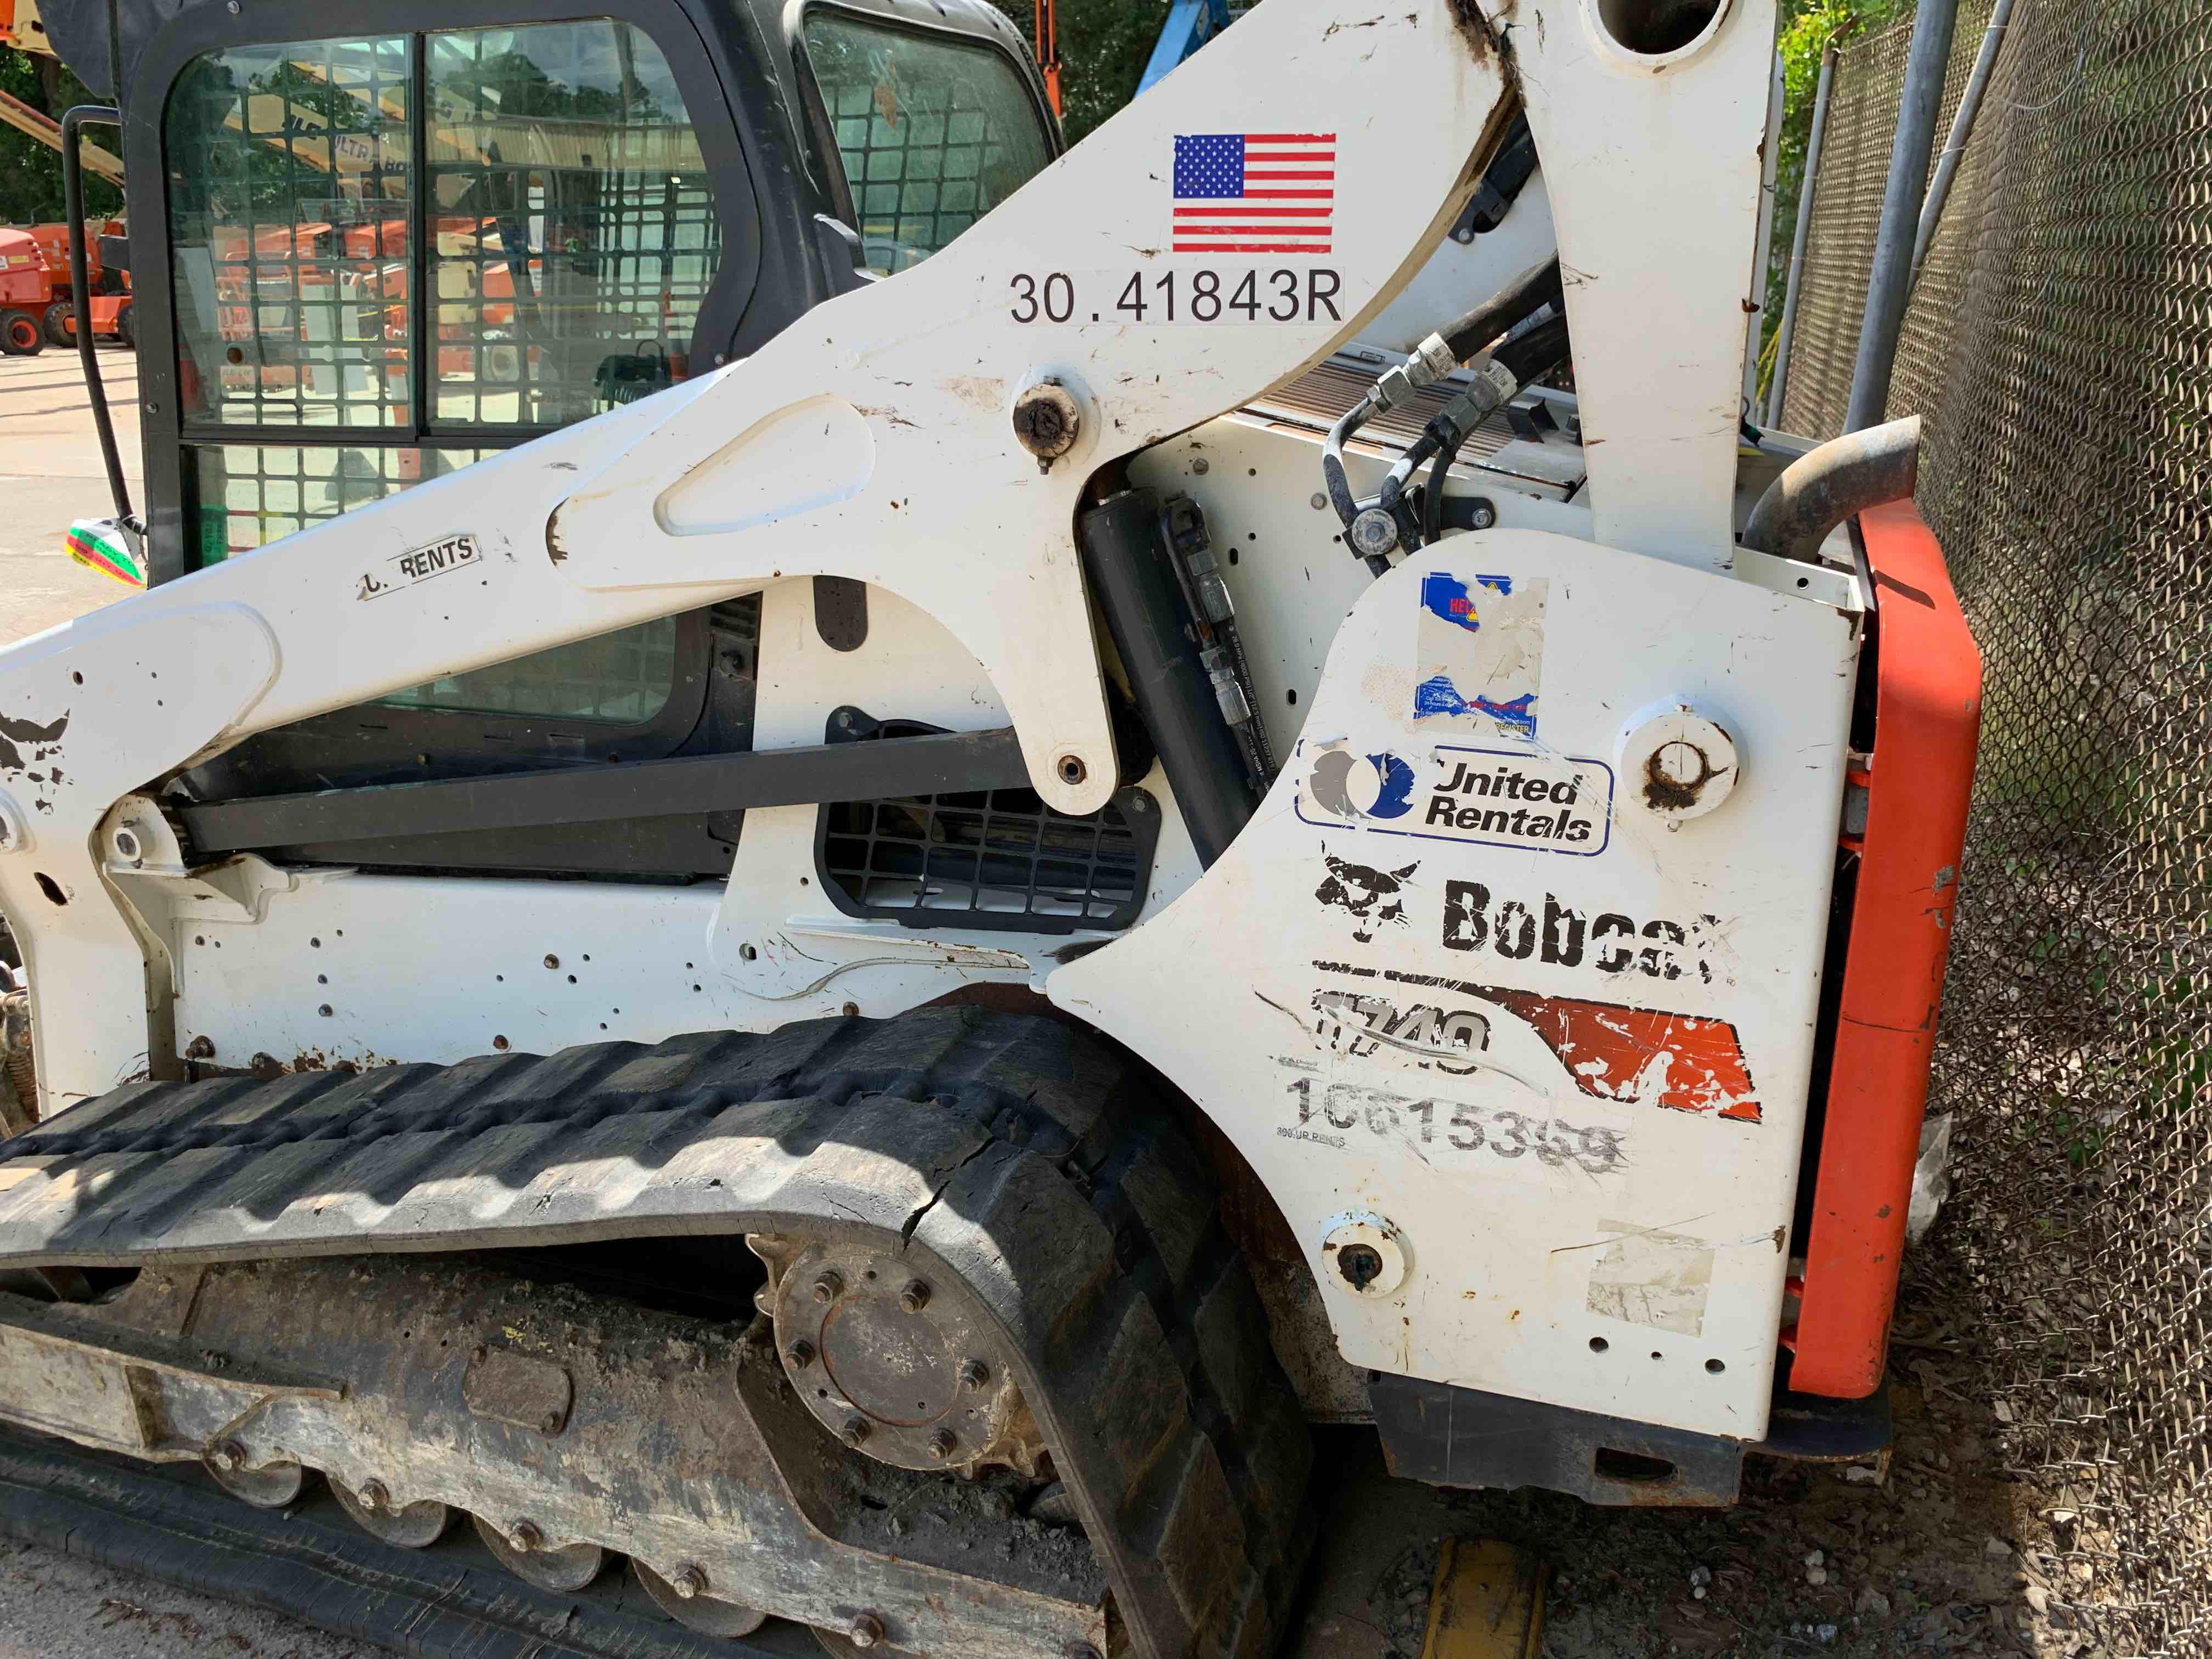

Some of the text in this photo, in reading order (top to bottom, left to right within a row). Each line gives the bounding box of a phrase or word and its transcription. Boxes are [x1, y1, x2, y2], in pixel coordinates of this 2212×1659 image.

[1010, 269, 1342, 323] 30.41843R
[400, 538, 472, 578] RENTS
[1425, 795, 1592, 842] Rentals
[1442, 880, 1727, 985] Bobca
